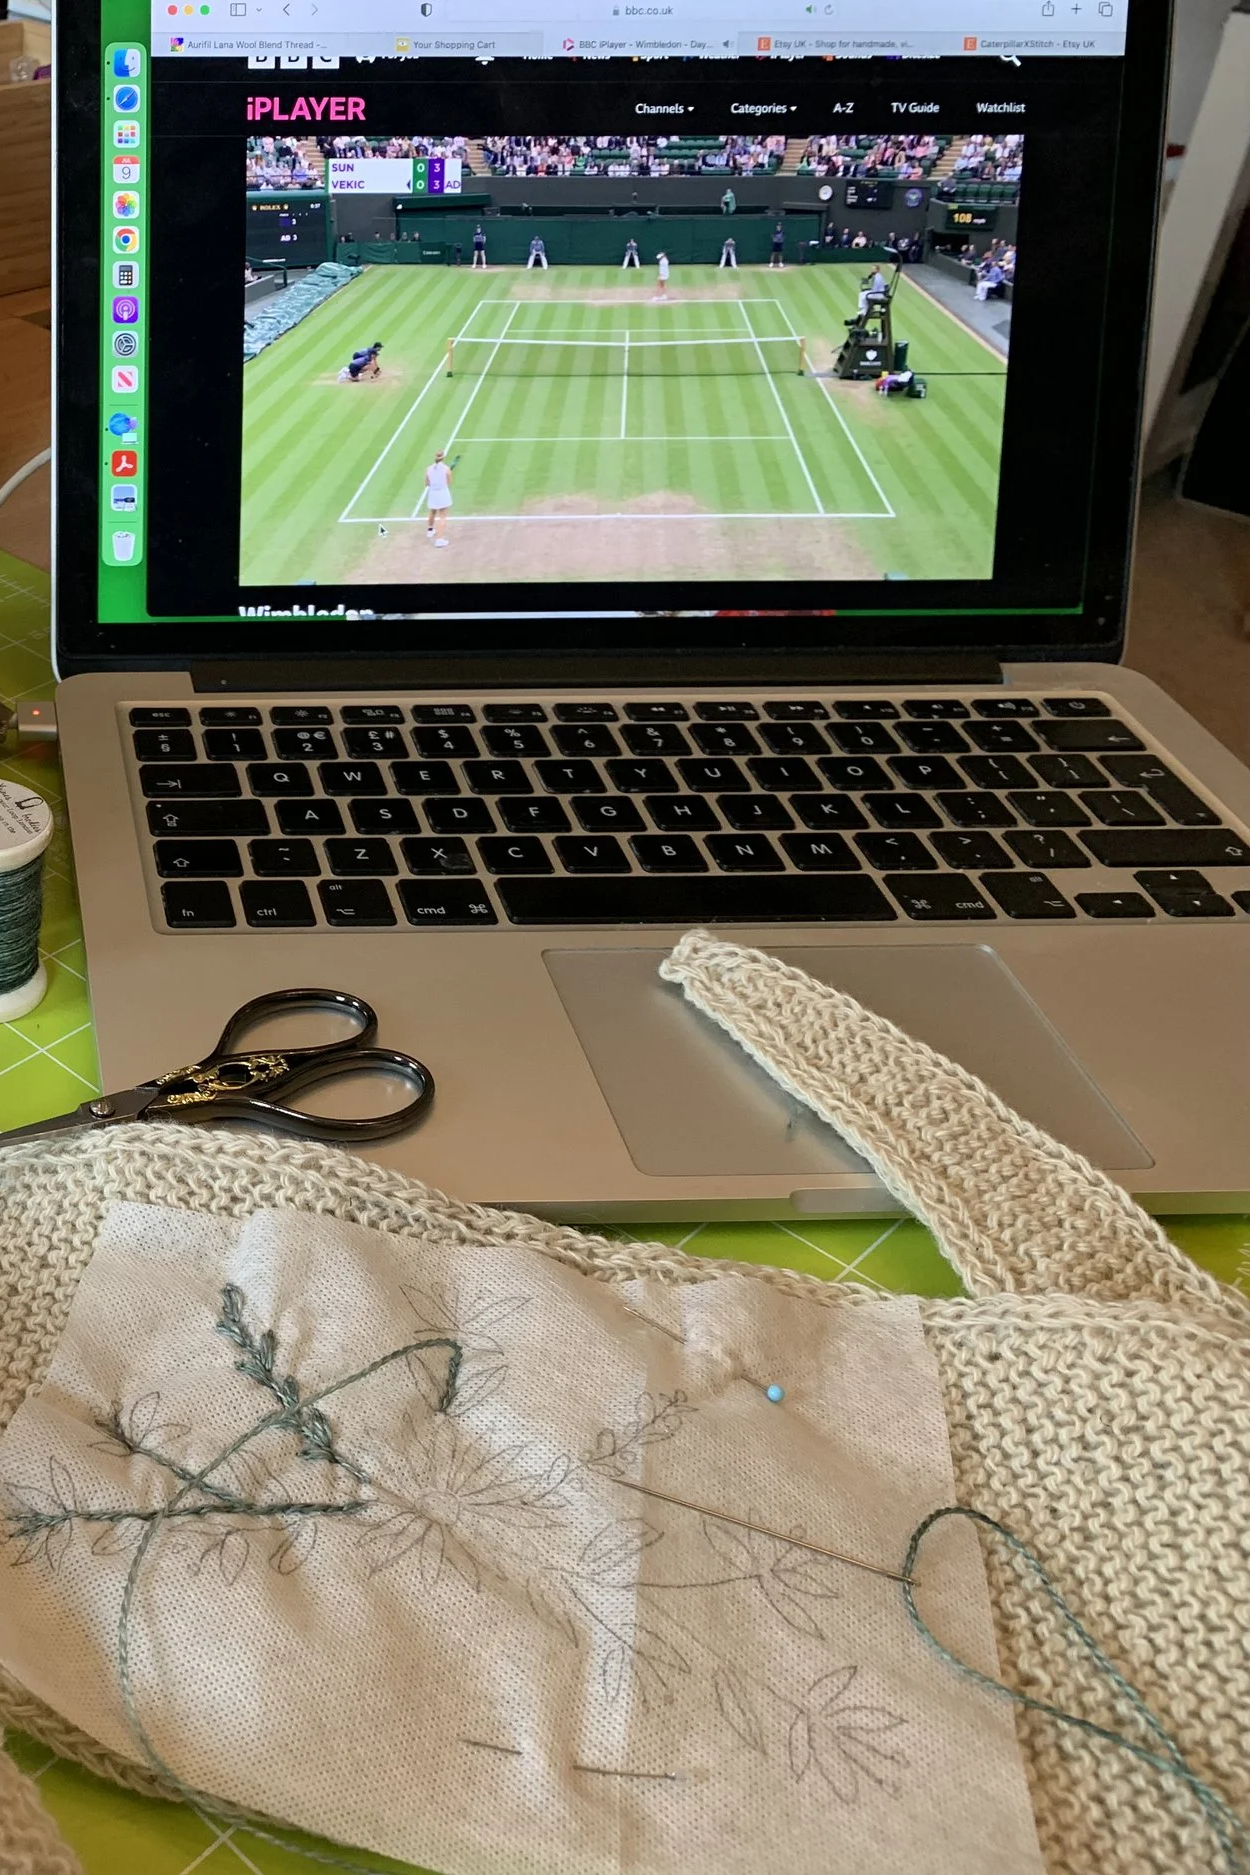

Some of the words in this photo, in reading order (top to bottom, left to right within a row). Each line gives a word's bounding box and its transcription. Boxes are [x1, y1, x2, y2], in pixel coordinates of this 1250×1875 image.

[625, 6, 673, 16] bbc.co.uk
[188, 41, 211, 49] Aurifil
[214, 41, 234, 49] Lana
[236, 41, 257, 49] Wool
[259, 41, 283, 49] Blend
[285, 41, 313, 49] Thread
[413, 41, 431, 49] Your
[434, 41, 475, 50] Shopping
[477, 41, 496, 49] Cart
[579, 41, 596, 49] BBC
[599, 41, 626, 50] iPlayer
[635, 41, 681, 49] Wimbledon
[774, 40, 791, 49] Etsy
[794, 40, 806, 48] UK
[815, 40, 836, 49] Shop
[839, 40, 850, 48] for
[852, 40, 896, 49] handmade,
[980, 40, 1054, 49] CaterpillarXStitch
[1063, 40, 1080, 49] Etsy
[1083, 40, 1095, 48] UK
[247, 97, 366, 121] iPLAYER
[635, 103, 684, 114] Channels
[730, 102, 787, 116] Categories
[833, 102, 855, 113] A-Z
[891, 102, 906, 113] TV
[908, 102, 940, 113] Guide
[976, 102, 1026, 113] Watchlist
[122, 166, 131, 180] 9
[331, 163, 354, 172] SUN
[416, 163, 425, 173] 0
[434, 163, 440, 172] 3
[331, 180, 365, 189] VEKIC
[416, 180, 425, 190] 0
[433, 180, 440, 189] 3
[445, 181, 461, 189] AD
[444, 741, 455, 750] 4
[514, 740, 524, 749] 5
[584, 739, 595, 748] 6
[654, 739, 663, 748] 7
[724, 738, 736, 747] 8
[792, 737, 804, 746] 9
[861, 736, 874, 746] 0
[233, 744, 240, 752] 1
[302, 743, 313, 751] 2
[373, 742, 383, 751] 3
[420, 770, 431, 781] E
[491, 770, 505, 780] R
[562, 769, 574, 779] T
[634, 768, 647, 778] Y
[704, 768, 722, 778] U
[780, 767, 789, 777] I
[847, 766, 864, 777] O
[919, 766, 932, 775] P
[274, 772, 290, 783] Q
[343, 771, 362, 782] W
[453, 808, 468, 818] D
[528, 807, 540, 817] F
[601, 806, 617, 817] G
[674, 805, 692, 816] H
[753, 805, 762, 816] J
[820, 804, 838, 815] K
[895, 804, 911, 813] L
[304, 809, 319, 820] A
[379, 808, 392, 820] S
[16, 819, 35, 834] London
[354, 849, 369, 859] Z
[431, 848, 447, 859] X
[508, 847, 524, 858] C
[584, 846, 598, 857] V
[663, 846, 677, 856] B
[735, 845, 754, 855] N
[811, 844, 832, 855] M
[955, 900, 984, 909] cmd
[182, 908, 195, 918] fn
[257, 908, 277, 917] ctrl
[417, 905, 446, 915] cmd
